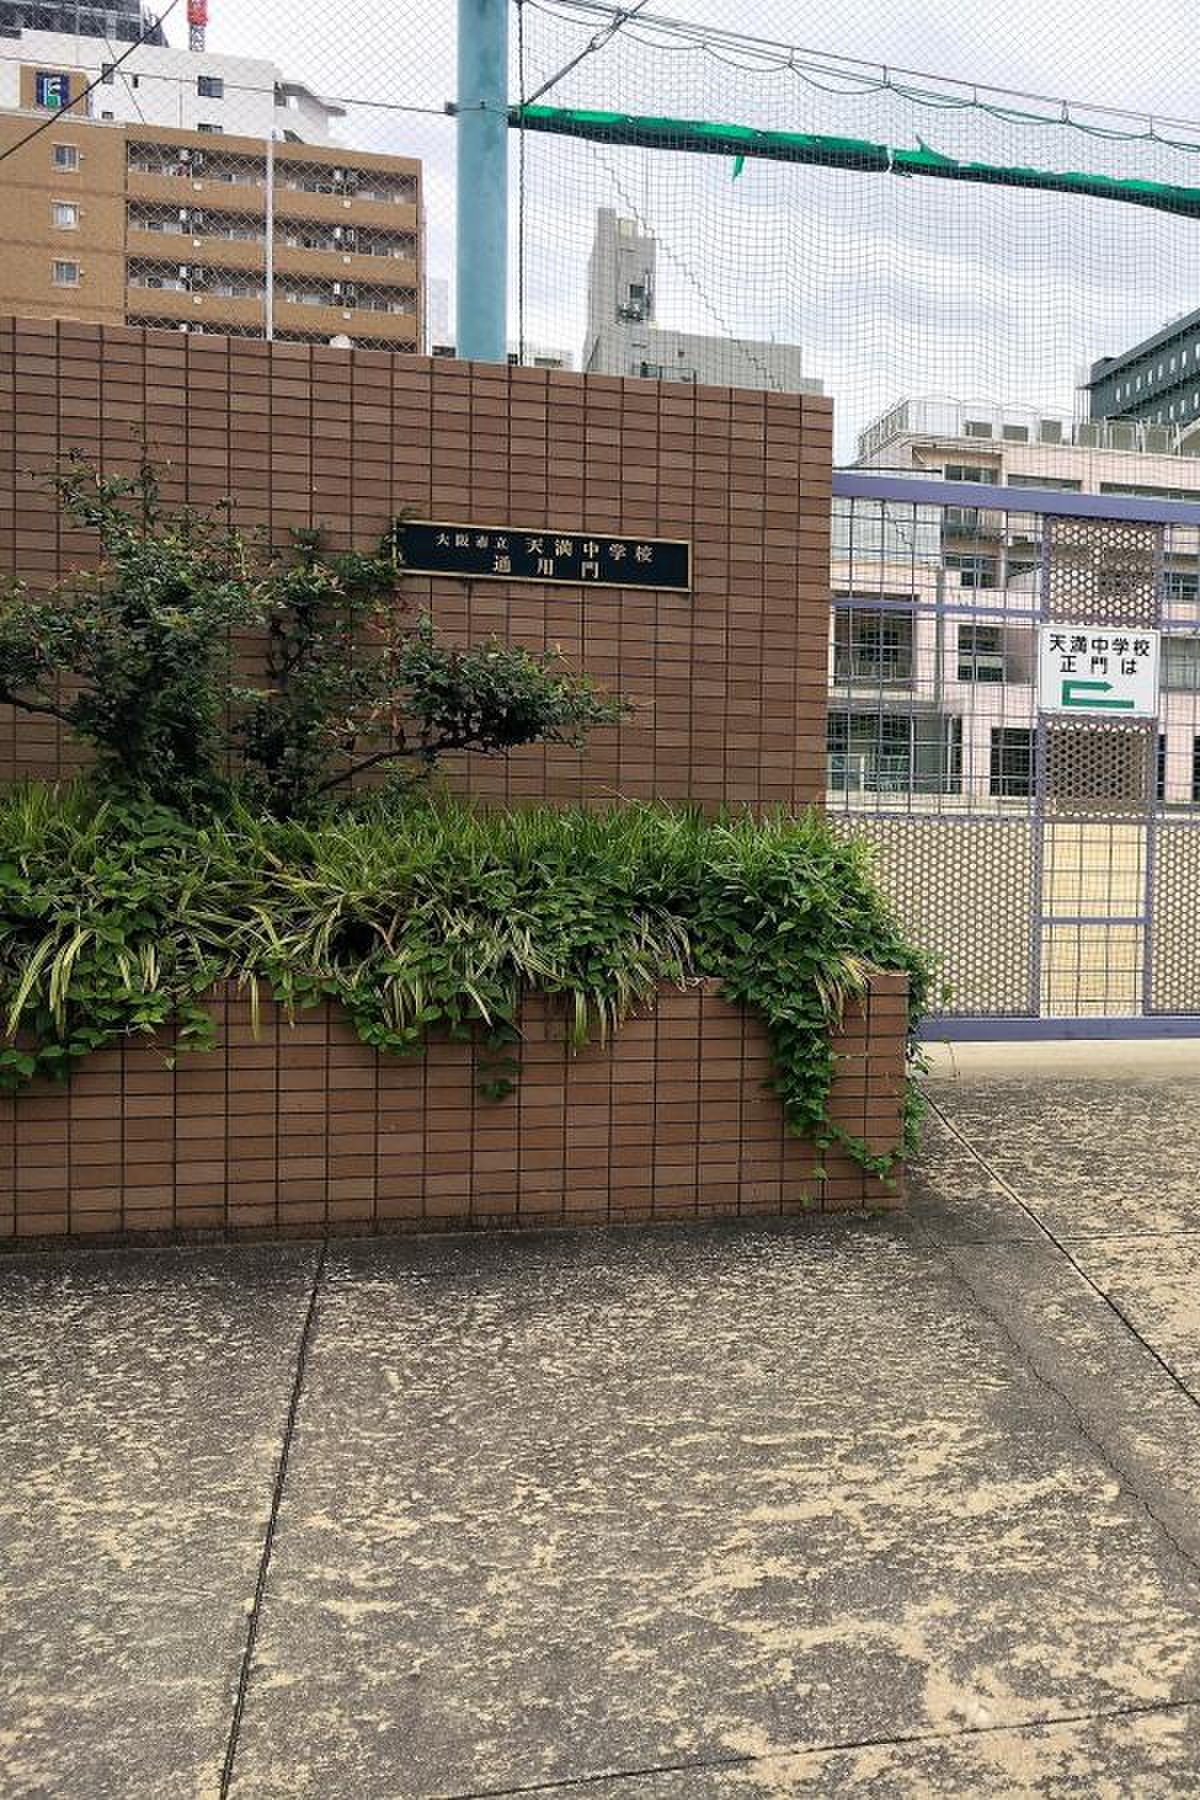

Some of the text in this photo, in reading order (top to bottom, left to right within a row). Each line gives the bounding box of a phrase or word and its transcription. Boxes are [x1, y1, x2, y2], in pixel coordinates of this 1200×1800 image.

[435, 532, 653, 563] 大阪市立 天満中学校
[1049, 633, 1150, 657] 天満中学校
[1059, 655, 1137, 675] 正門は
